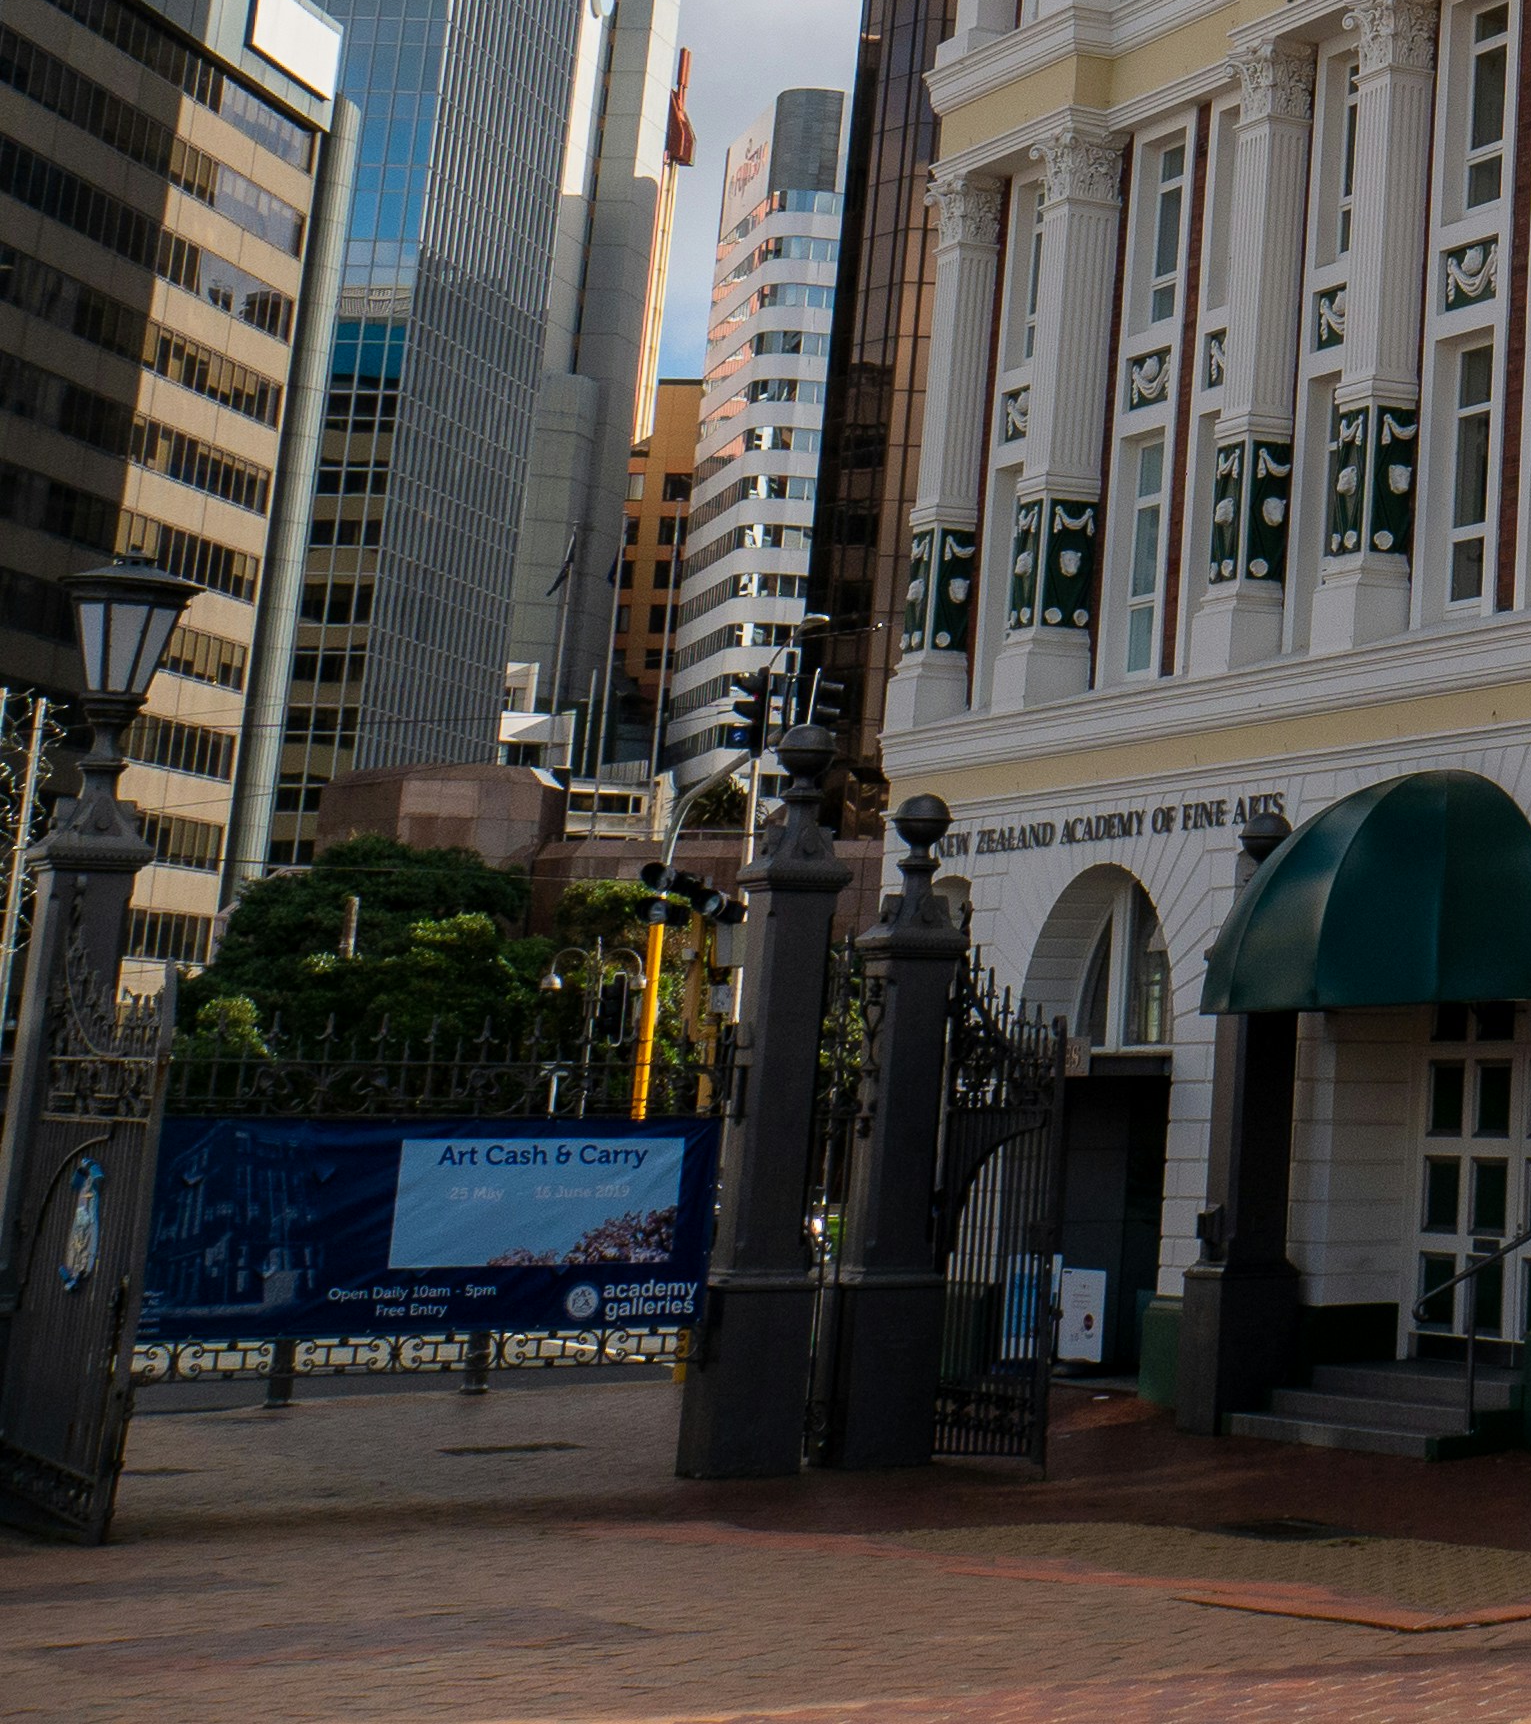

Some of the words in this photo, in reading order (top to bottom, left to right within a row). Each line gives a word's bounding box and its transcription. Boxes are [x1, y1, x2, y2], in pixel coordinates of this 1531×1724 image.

[934, 830, 972, 858] NEW
[975, 821, 1057, 854] ZEALAND
[1059, 808, 1147, 845] ACADEMY
[1151, 805, 1178, 835] OF
[1181, 798, 1228, 831] FINE
[1231, 791, 1285, 825] ARTS
[437, 1144, 479, 1167] Art
[486, 1144, 548, 1167] Cash
[555, 1144, 573, 1165] &
[579, 1144, 649, 1169] Carry
[473, 1186, 504, 1201] May
[555, 1184, 592, 1200] June
[328, 1287, 369, 1303] Open
[372, 1285, 409, 1302] Daily
[412, 1284, 451, 1299] 10am
[464, 1284, 498, 1299] 5pm
[603, 1278, 698, 1300] academy
[375, 1304, 406, 1317] Free
[409, 1303, 448, 1318] Entry
[604, 1296, 694, 1321] galleries
